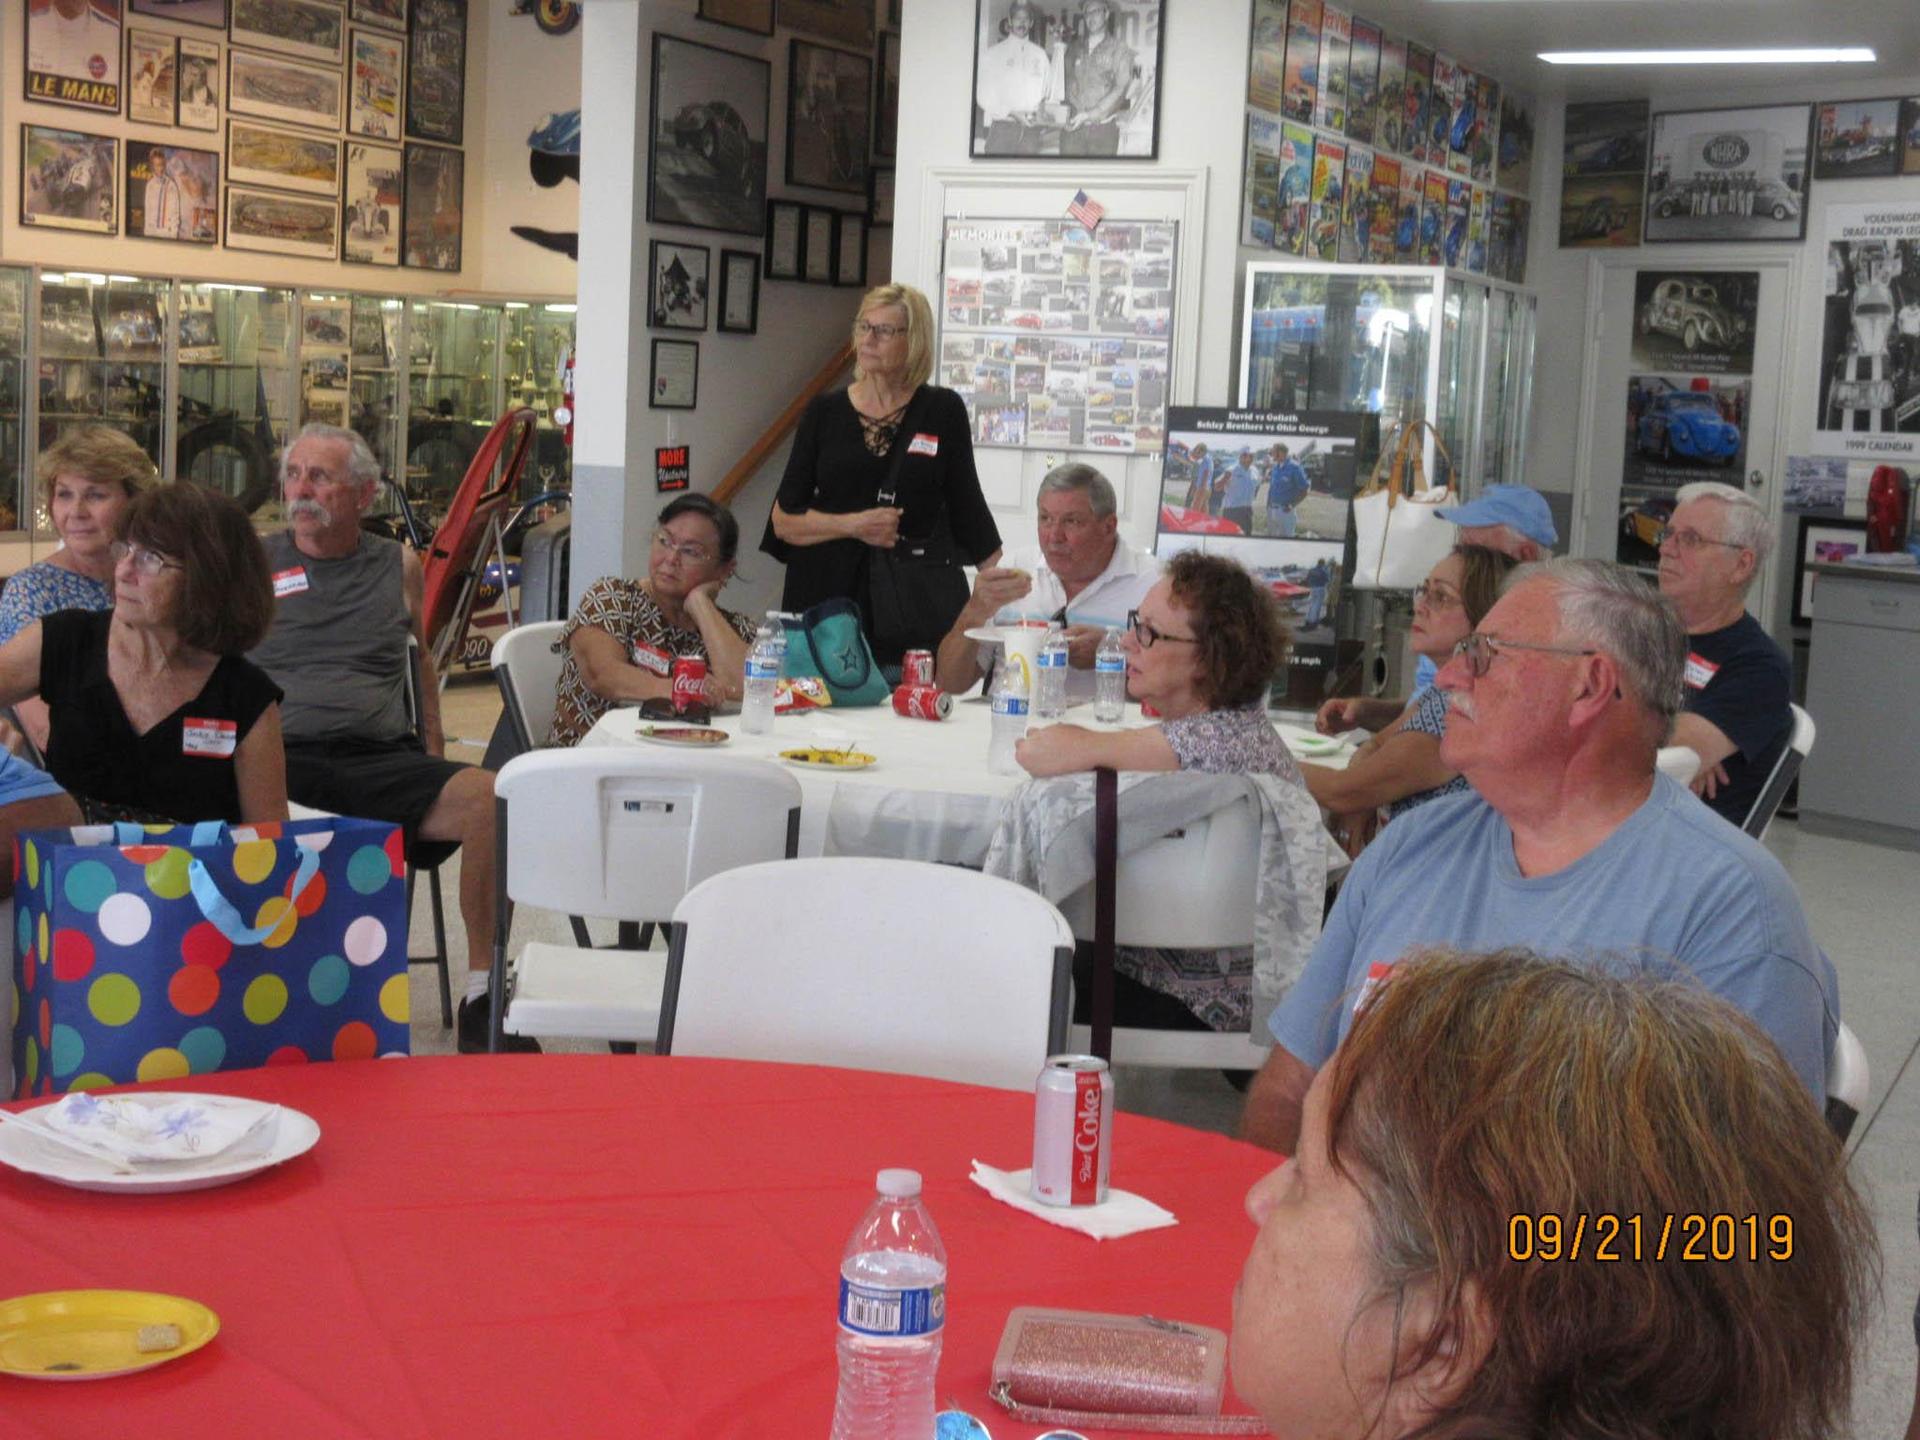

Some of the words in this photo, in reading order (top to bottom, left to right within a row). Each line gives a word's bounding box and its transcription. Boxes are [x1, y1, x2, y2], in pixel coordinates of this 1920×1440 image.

[31, 74, 56, 96] LE
[61, 79, 117, 106] MANS
[1711, 143, 1742, 162] NHRA
[1842, 226, 1868, 238] DRAG
[1869, 225, 1904, 237] RACING
[1228, 411, 1253, 421] David
[1266, 412, 1298, 422] Goliath
[1226, 421, 1263, 431] Brothers
[1265, 423, 1274, 431] vs
[1276, 423, 1297, 432] Ohio
[1299, 424, 1329, 434] George
[1845, 440, 1866, 451] 1999
[1868, 440, 1914, 452] CALENDAR
[659, 448, 685, 467] MORE
[1301, 655, 1322, 667] mph
[1075, 1088, 1101, 1153] Coke
